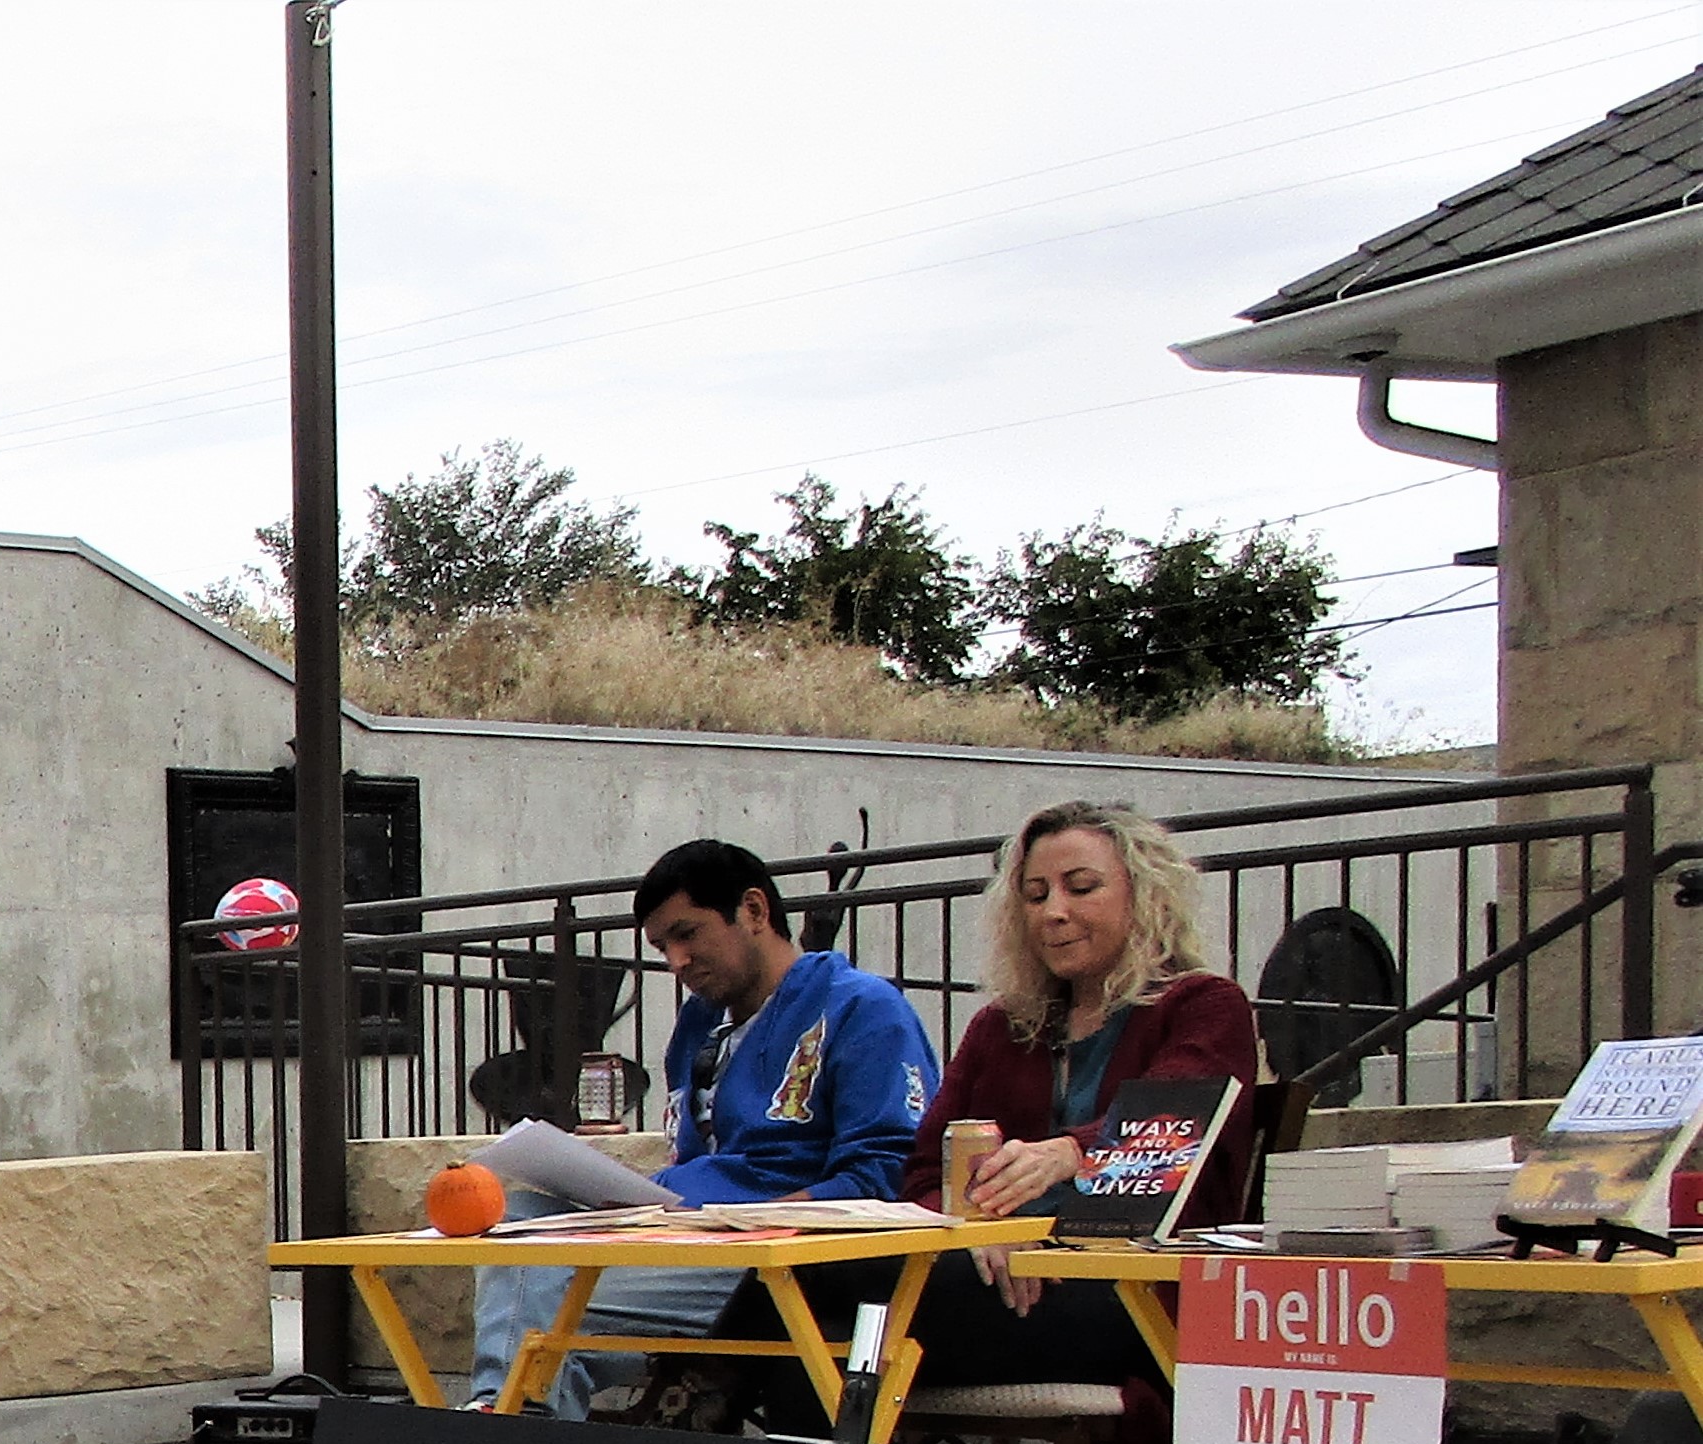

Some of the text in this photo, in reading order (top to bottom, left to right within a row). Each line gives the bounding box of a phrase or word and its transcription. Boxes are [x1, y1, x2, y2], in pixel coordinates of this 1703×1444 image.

[1577, 1095, 1682, 1117] HERE
[1120, 1119, 1194, 1137] WAYS
[1130, 1138, 1167, 1149] AND
[1094, 1150, 1190, 1165] TRUTHS
[1119, 1168, 1153, 1177] AND
[1093, 1179, 1164, 1195] LIVES
[1234, 1265, 1395, 1349] hello
